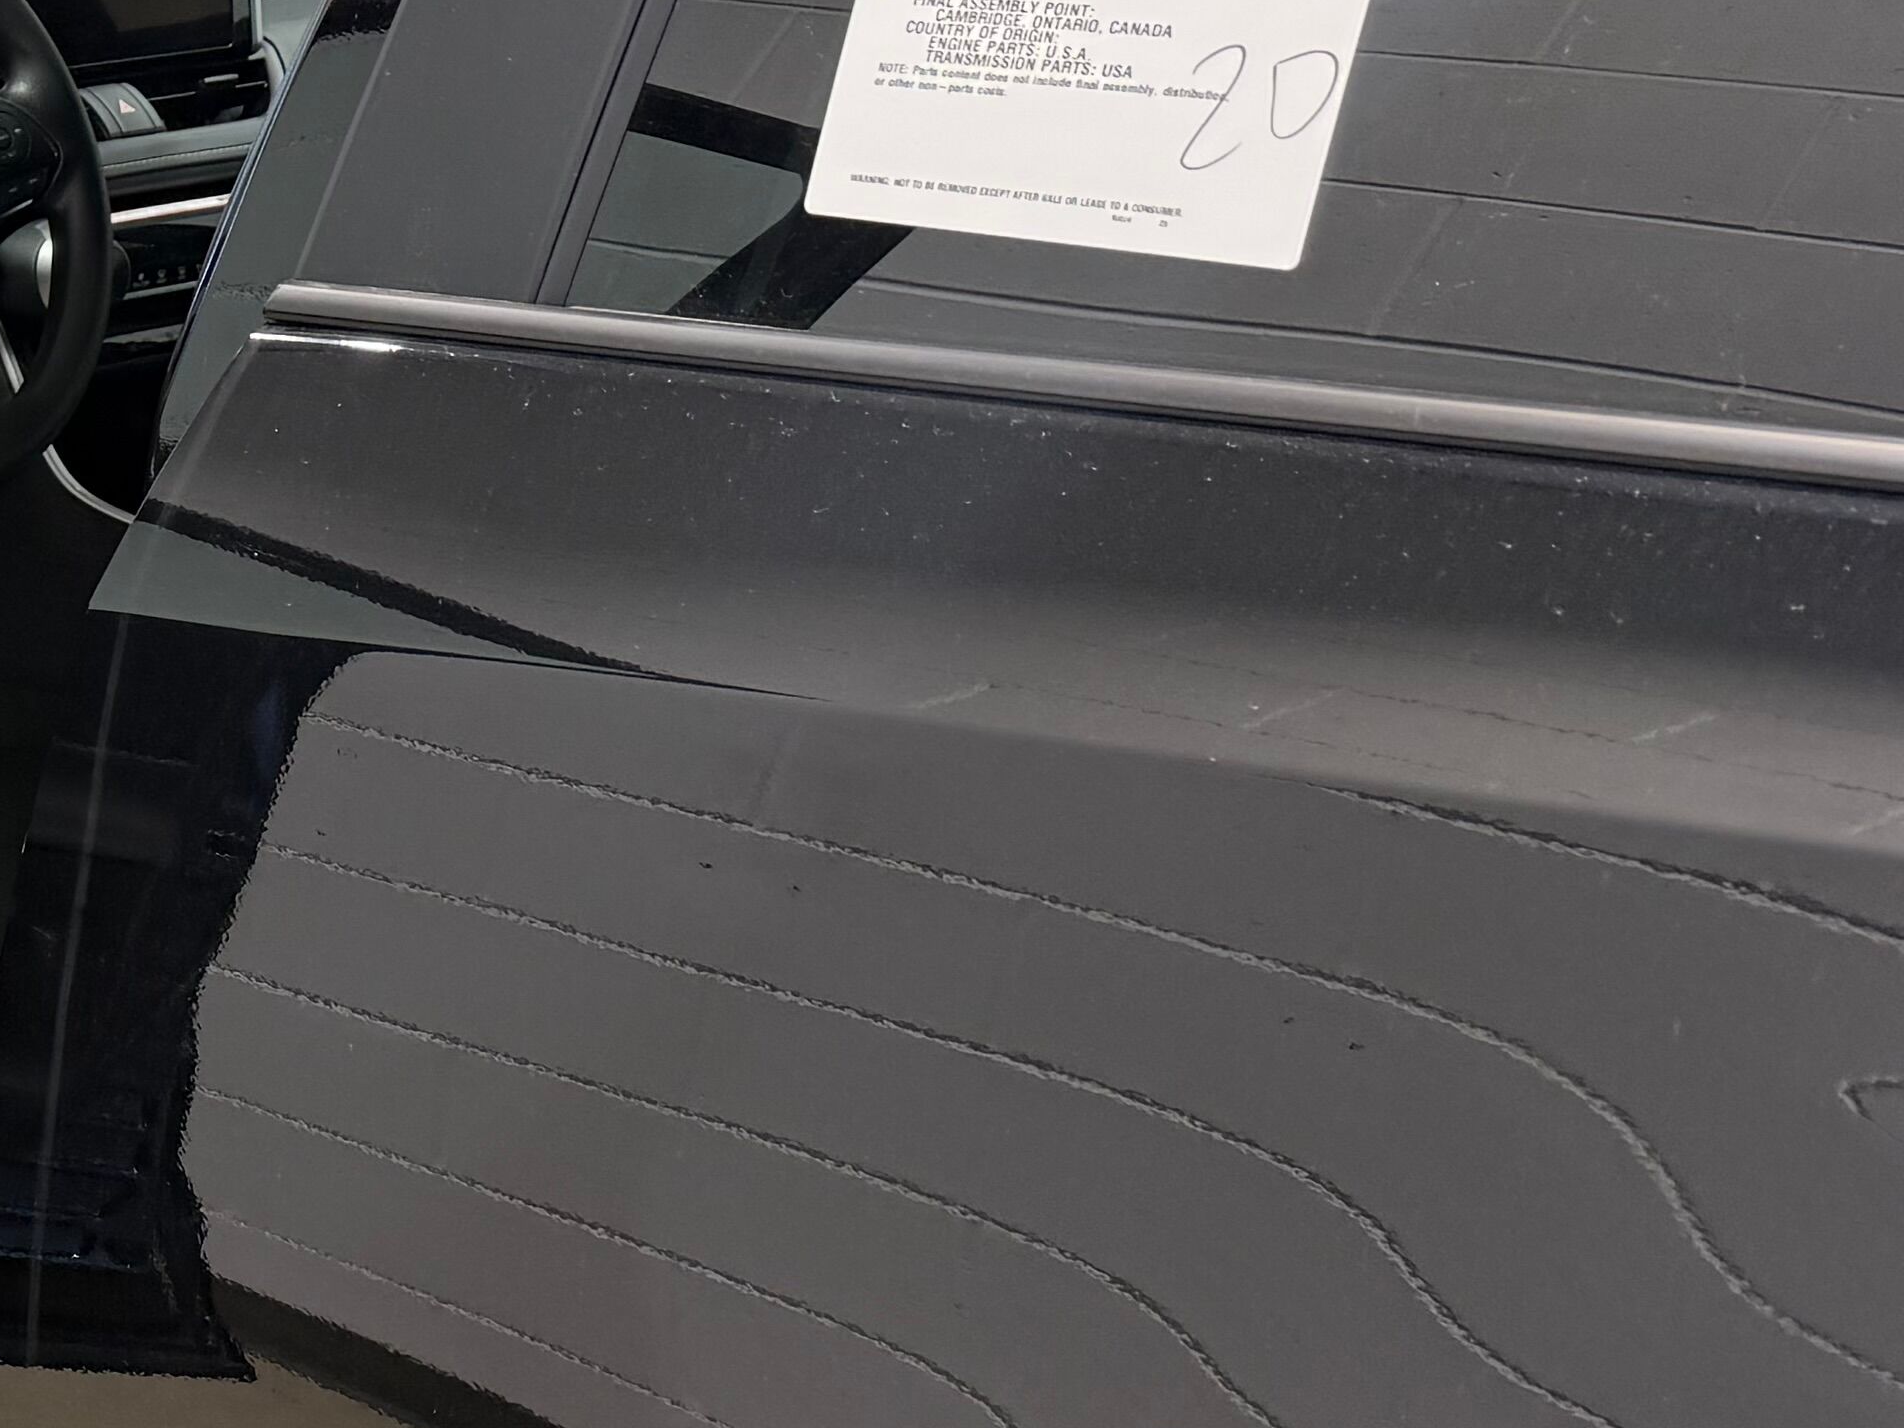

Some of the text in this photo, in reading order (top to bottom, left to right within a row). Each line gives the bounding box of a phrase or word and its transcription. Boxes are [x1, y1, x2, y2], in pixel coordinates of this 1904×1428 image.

[1044, 2, 1095, 17] POINT:
[906, 20, 1060, 44] COUNTRY OF ORIGIN:
[1109, 21, 1173, 38] CANADA
[928, 36, 1091, 61] ENGINE PARTS: U.S.A.
[878, 62, 909, 74] NOTE:
[913, 65, 938, 76] Parts
[942, 67, 981, 80] content
[984, 71, 1008, 82] does
[1012, 74, 1029, 84] not
[1032, 75, 1072, 88] include
[1076, 80, 1099, 90] final
[926, 50, 1133, 78] TRANSMISSION PARTS: USA
[874, 77, 886, 86] or
[888, 78, 914, 89] other
[893, 178, 910, 188] NOT
[913, 179, 923, 189] TO
[937, 182, 977, 195] REMOVED
[979, 186, 1010, 199] EXCEPT
[1013, 191, 1039, 202] AFTER
[1065, 196, 1078, 206] OR
[1080, 197, 1106, 209] LEASE
[1110, 200, 1121, 211] TO
